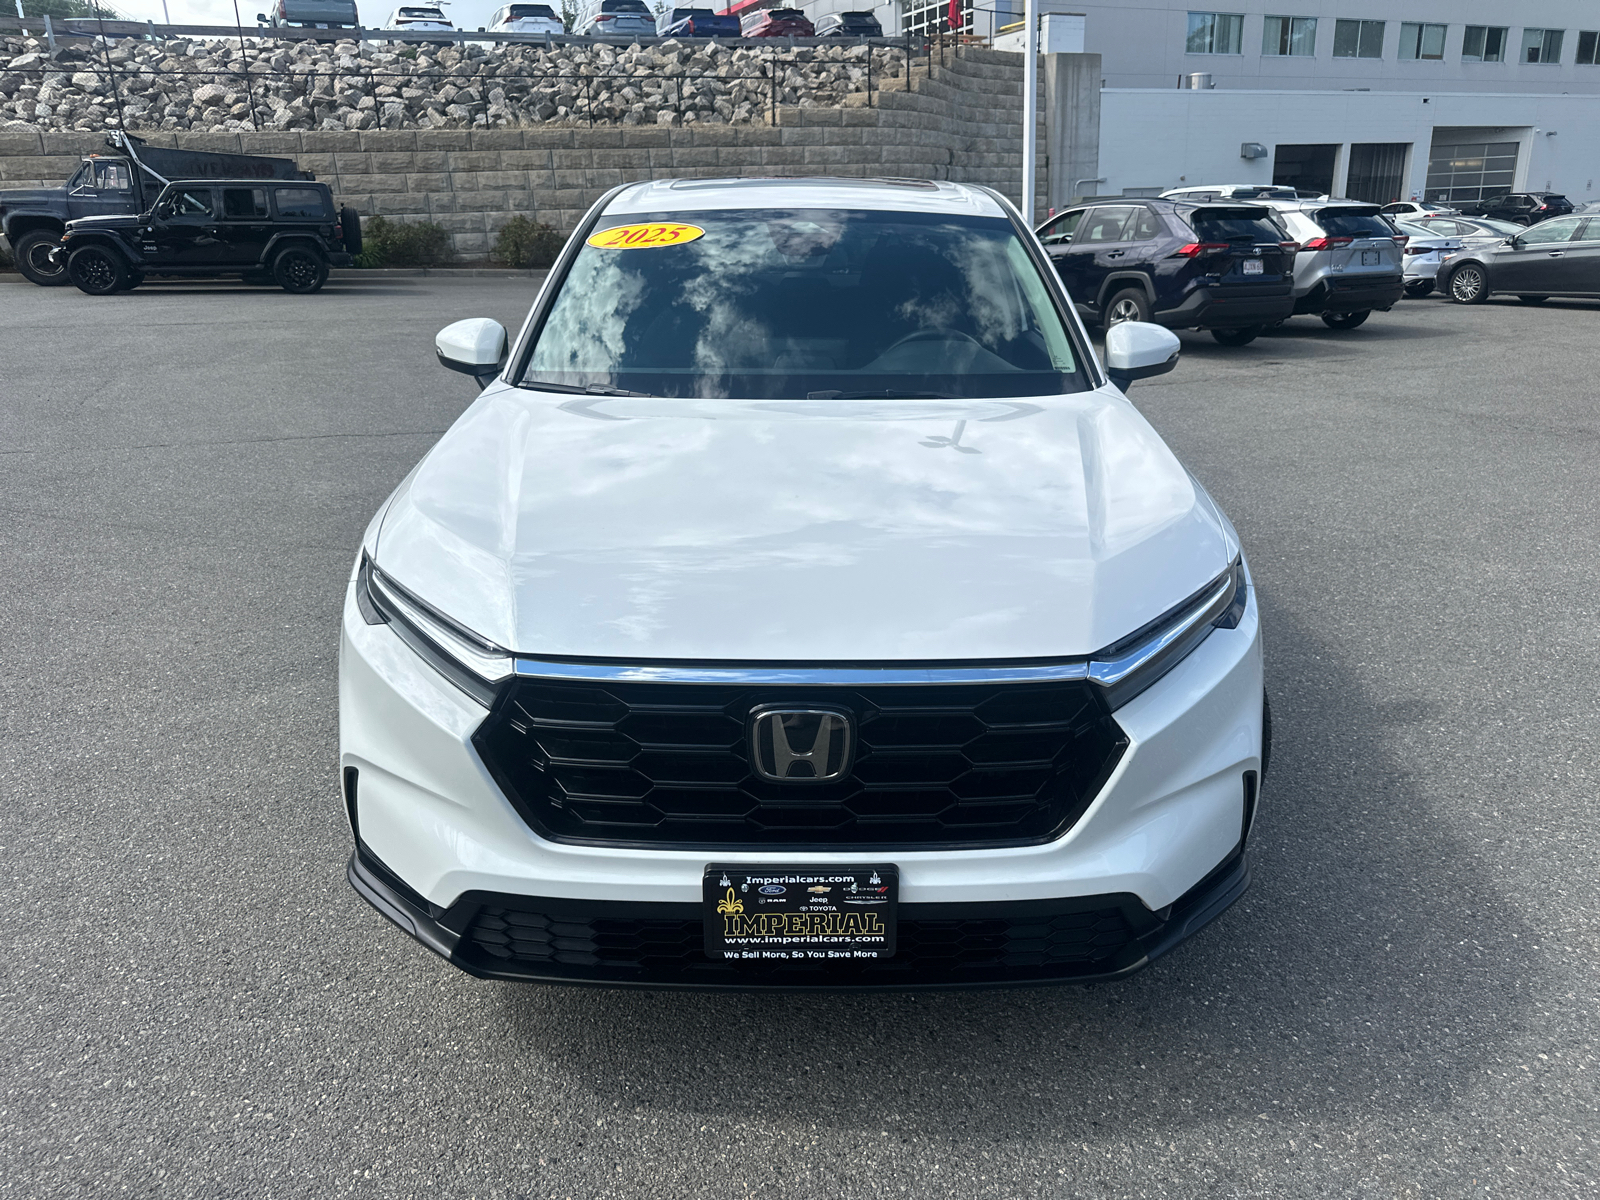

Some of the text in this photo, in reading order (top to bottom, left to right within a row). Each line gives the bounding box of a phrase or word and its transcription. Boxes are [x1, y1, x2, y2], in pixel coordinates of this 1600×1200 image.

[603, 227, 688, 246] 2025
[746, 875, 855, 885] Imperialcars.com
[724, 912, 885, 936] IMPERIAL
[724, 935, 885, 945] www.imperialcars.com
[724, 950, 878, 960] We Sell More, So You Save More
